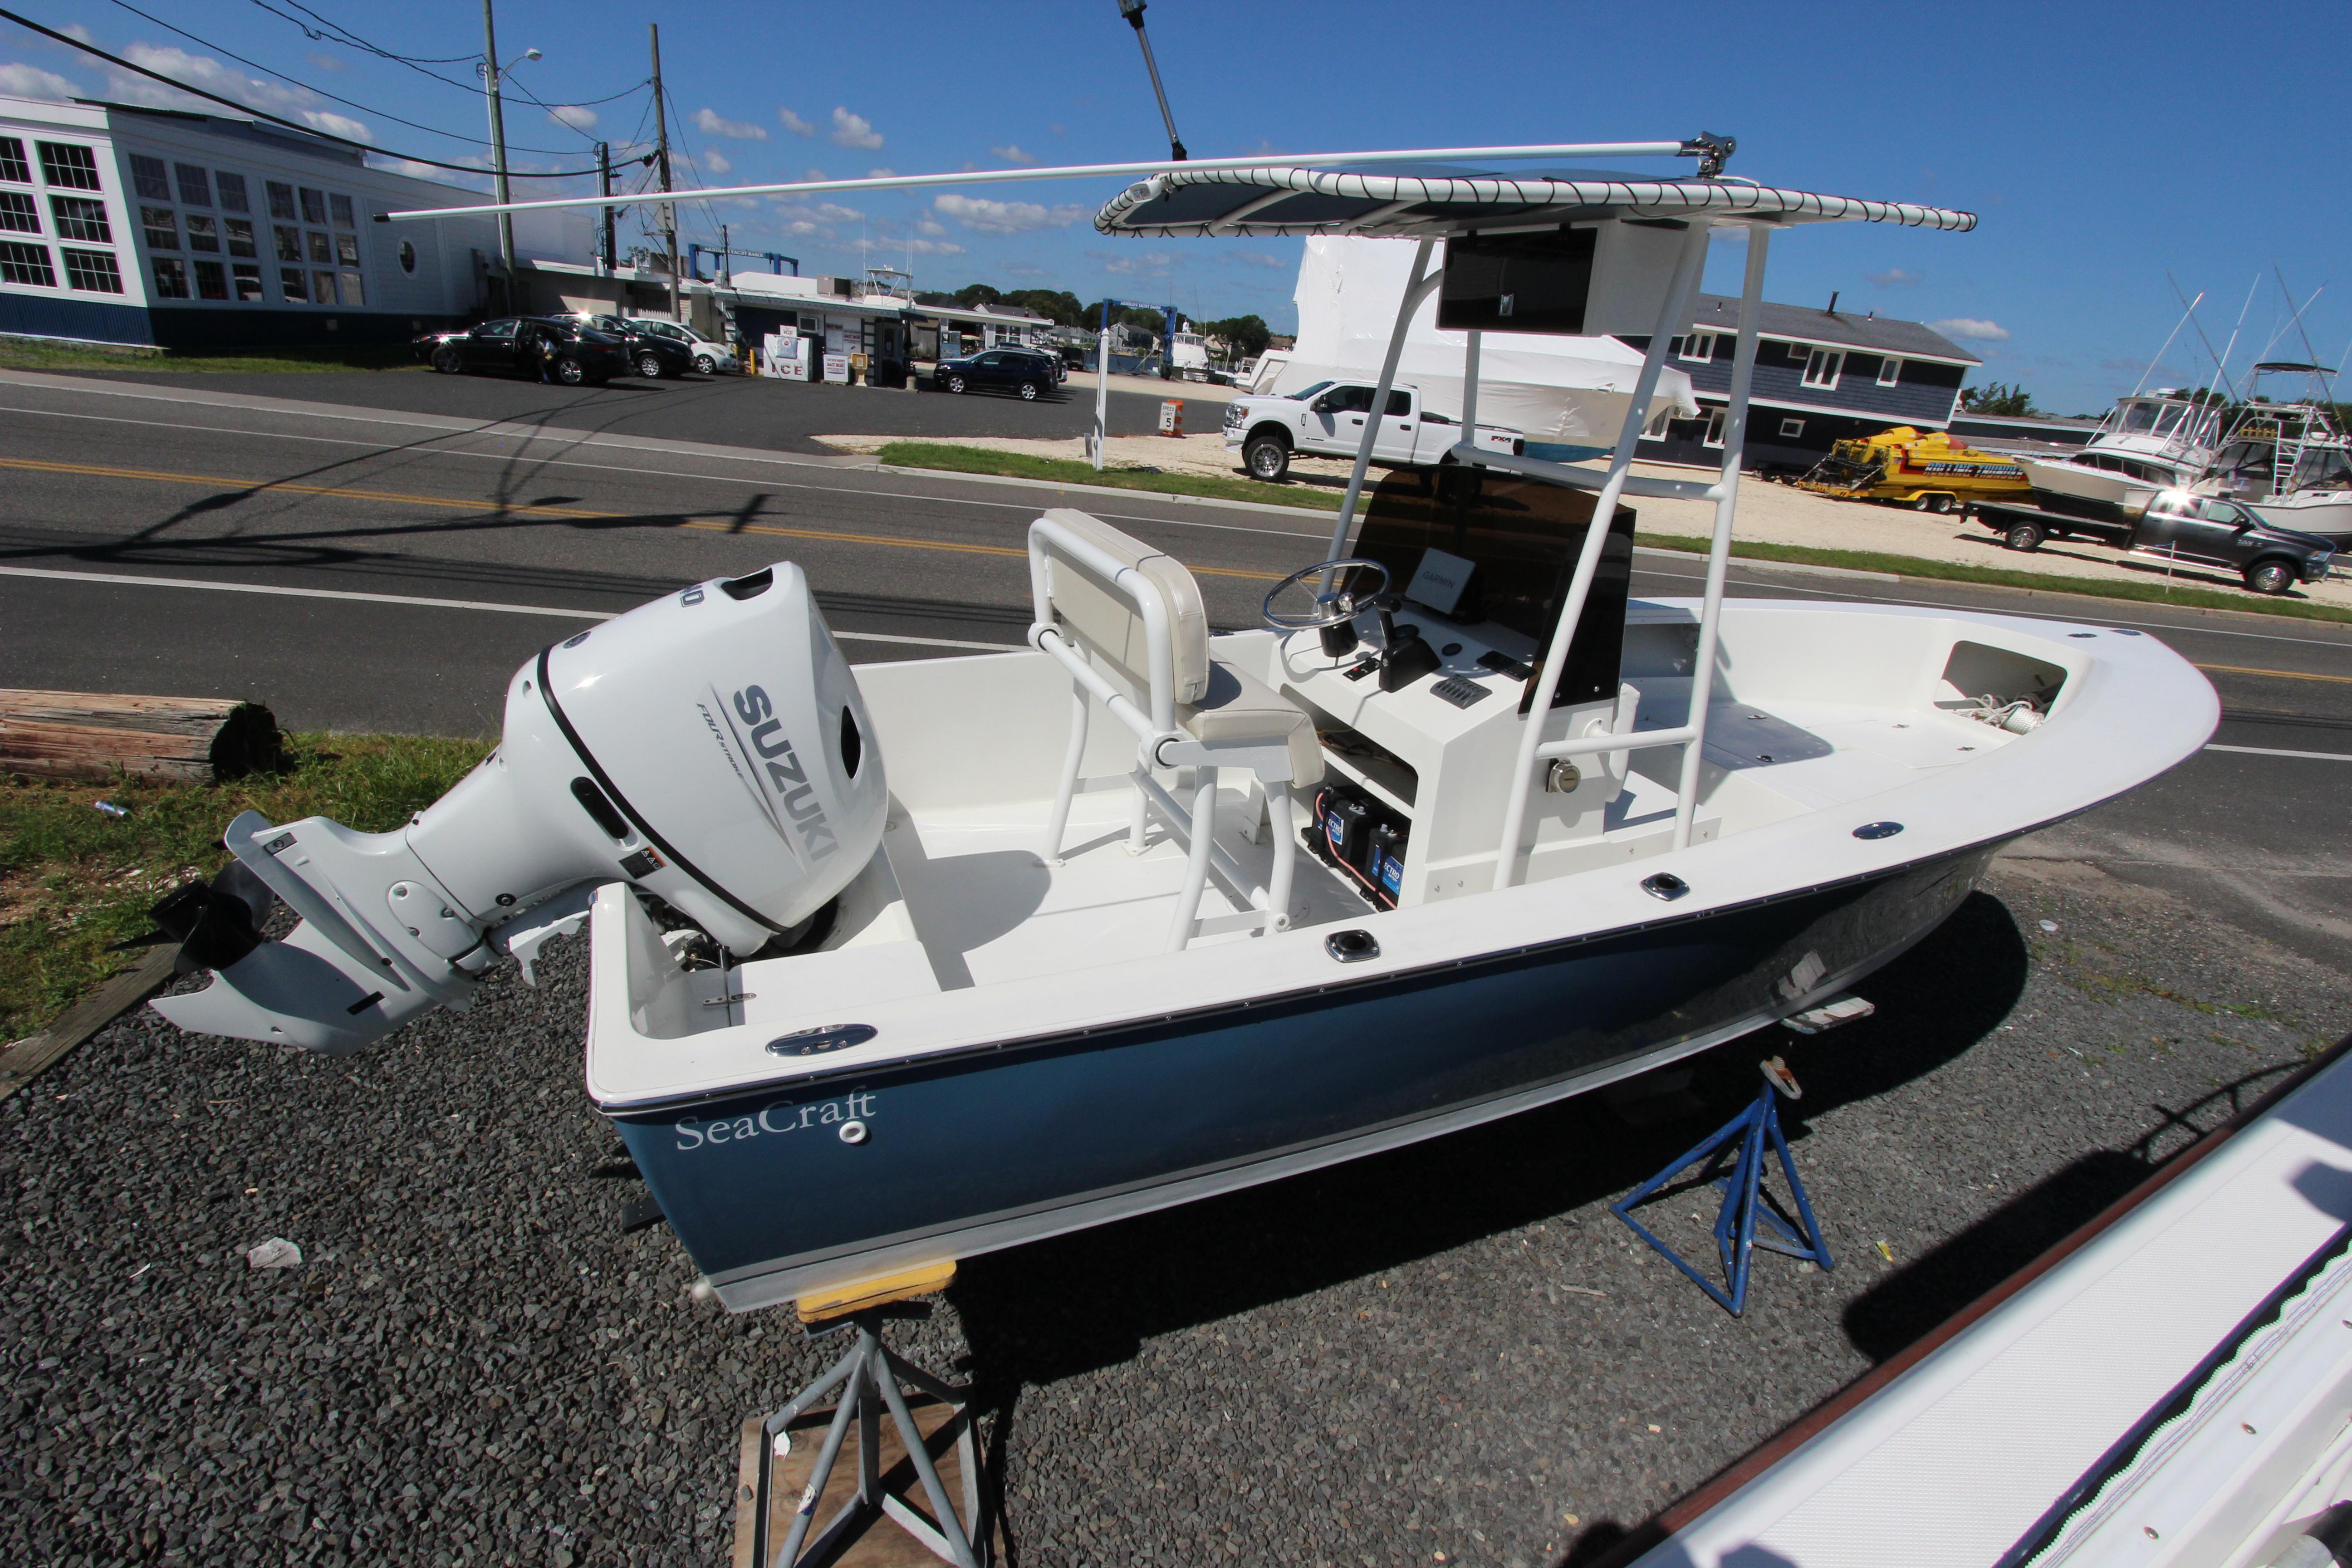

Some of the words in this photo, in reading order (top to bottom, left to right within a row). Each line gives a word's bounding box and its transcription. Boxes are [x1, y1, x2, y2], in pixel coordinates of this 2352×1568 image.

[772, 363, 803, 376] ICE
[1166, 417, 1171, 427] 5
[1422, 571, 1455, 589] GARMIN
[696, 703, 724, 740] FOUR
[719, 741, 744, 779] STROKE
[733, 685, 839, 862] SUZUKI
[1328, 818, 1342, 833] ECTRO
[1384, 862, 1400, 879] ECTRO
[675, 1085, 876, 1150] SeaCraft
